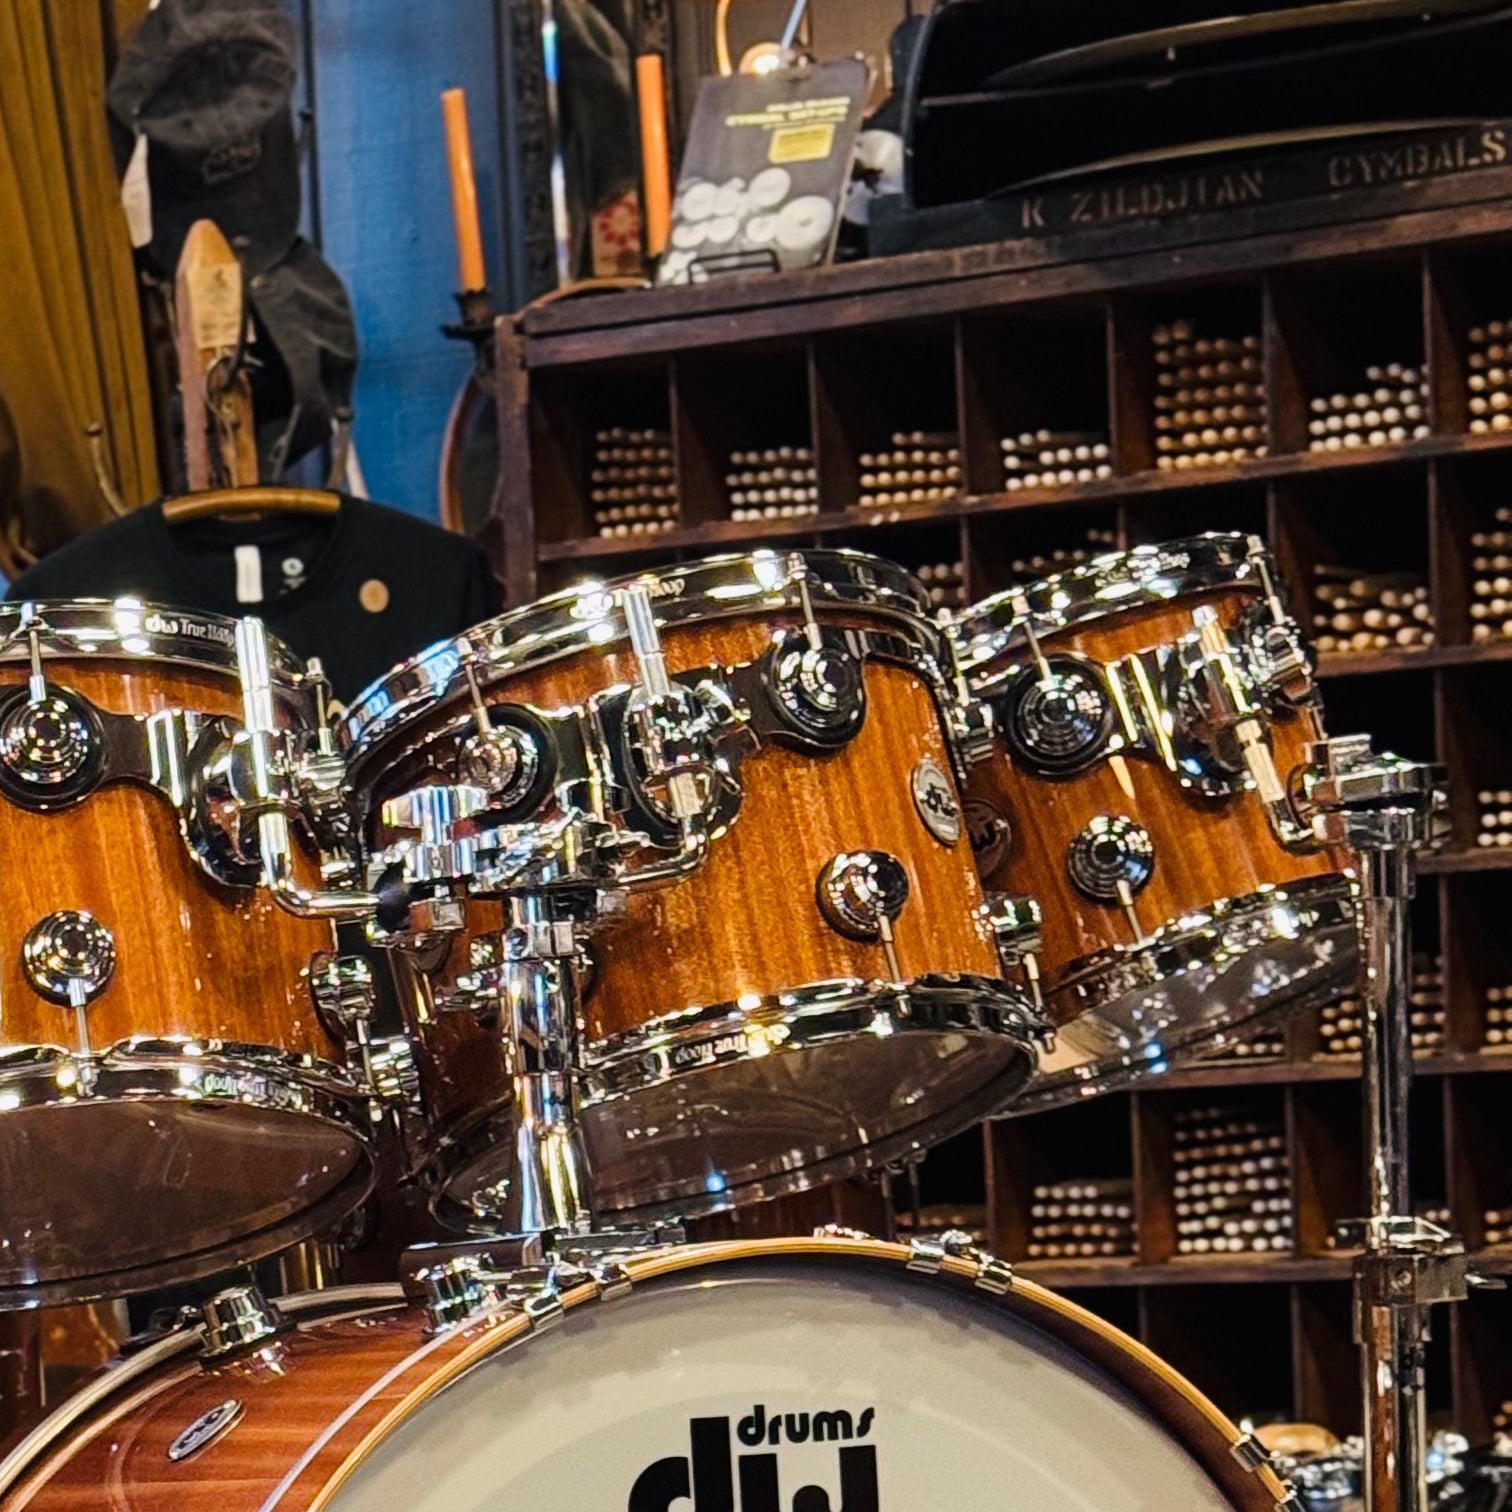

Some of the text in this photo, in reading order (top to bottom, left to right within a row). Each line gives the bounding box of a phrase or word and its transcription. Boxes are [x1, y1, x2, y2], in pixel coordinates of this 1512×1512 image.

[1020, 129, 1506, 229] K ZILDJIAN CYMBALS
[179, 618, 206, 639] True
[736, 1404, 876, 1447] drums
